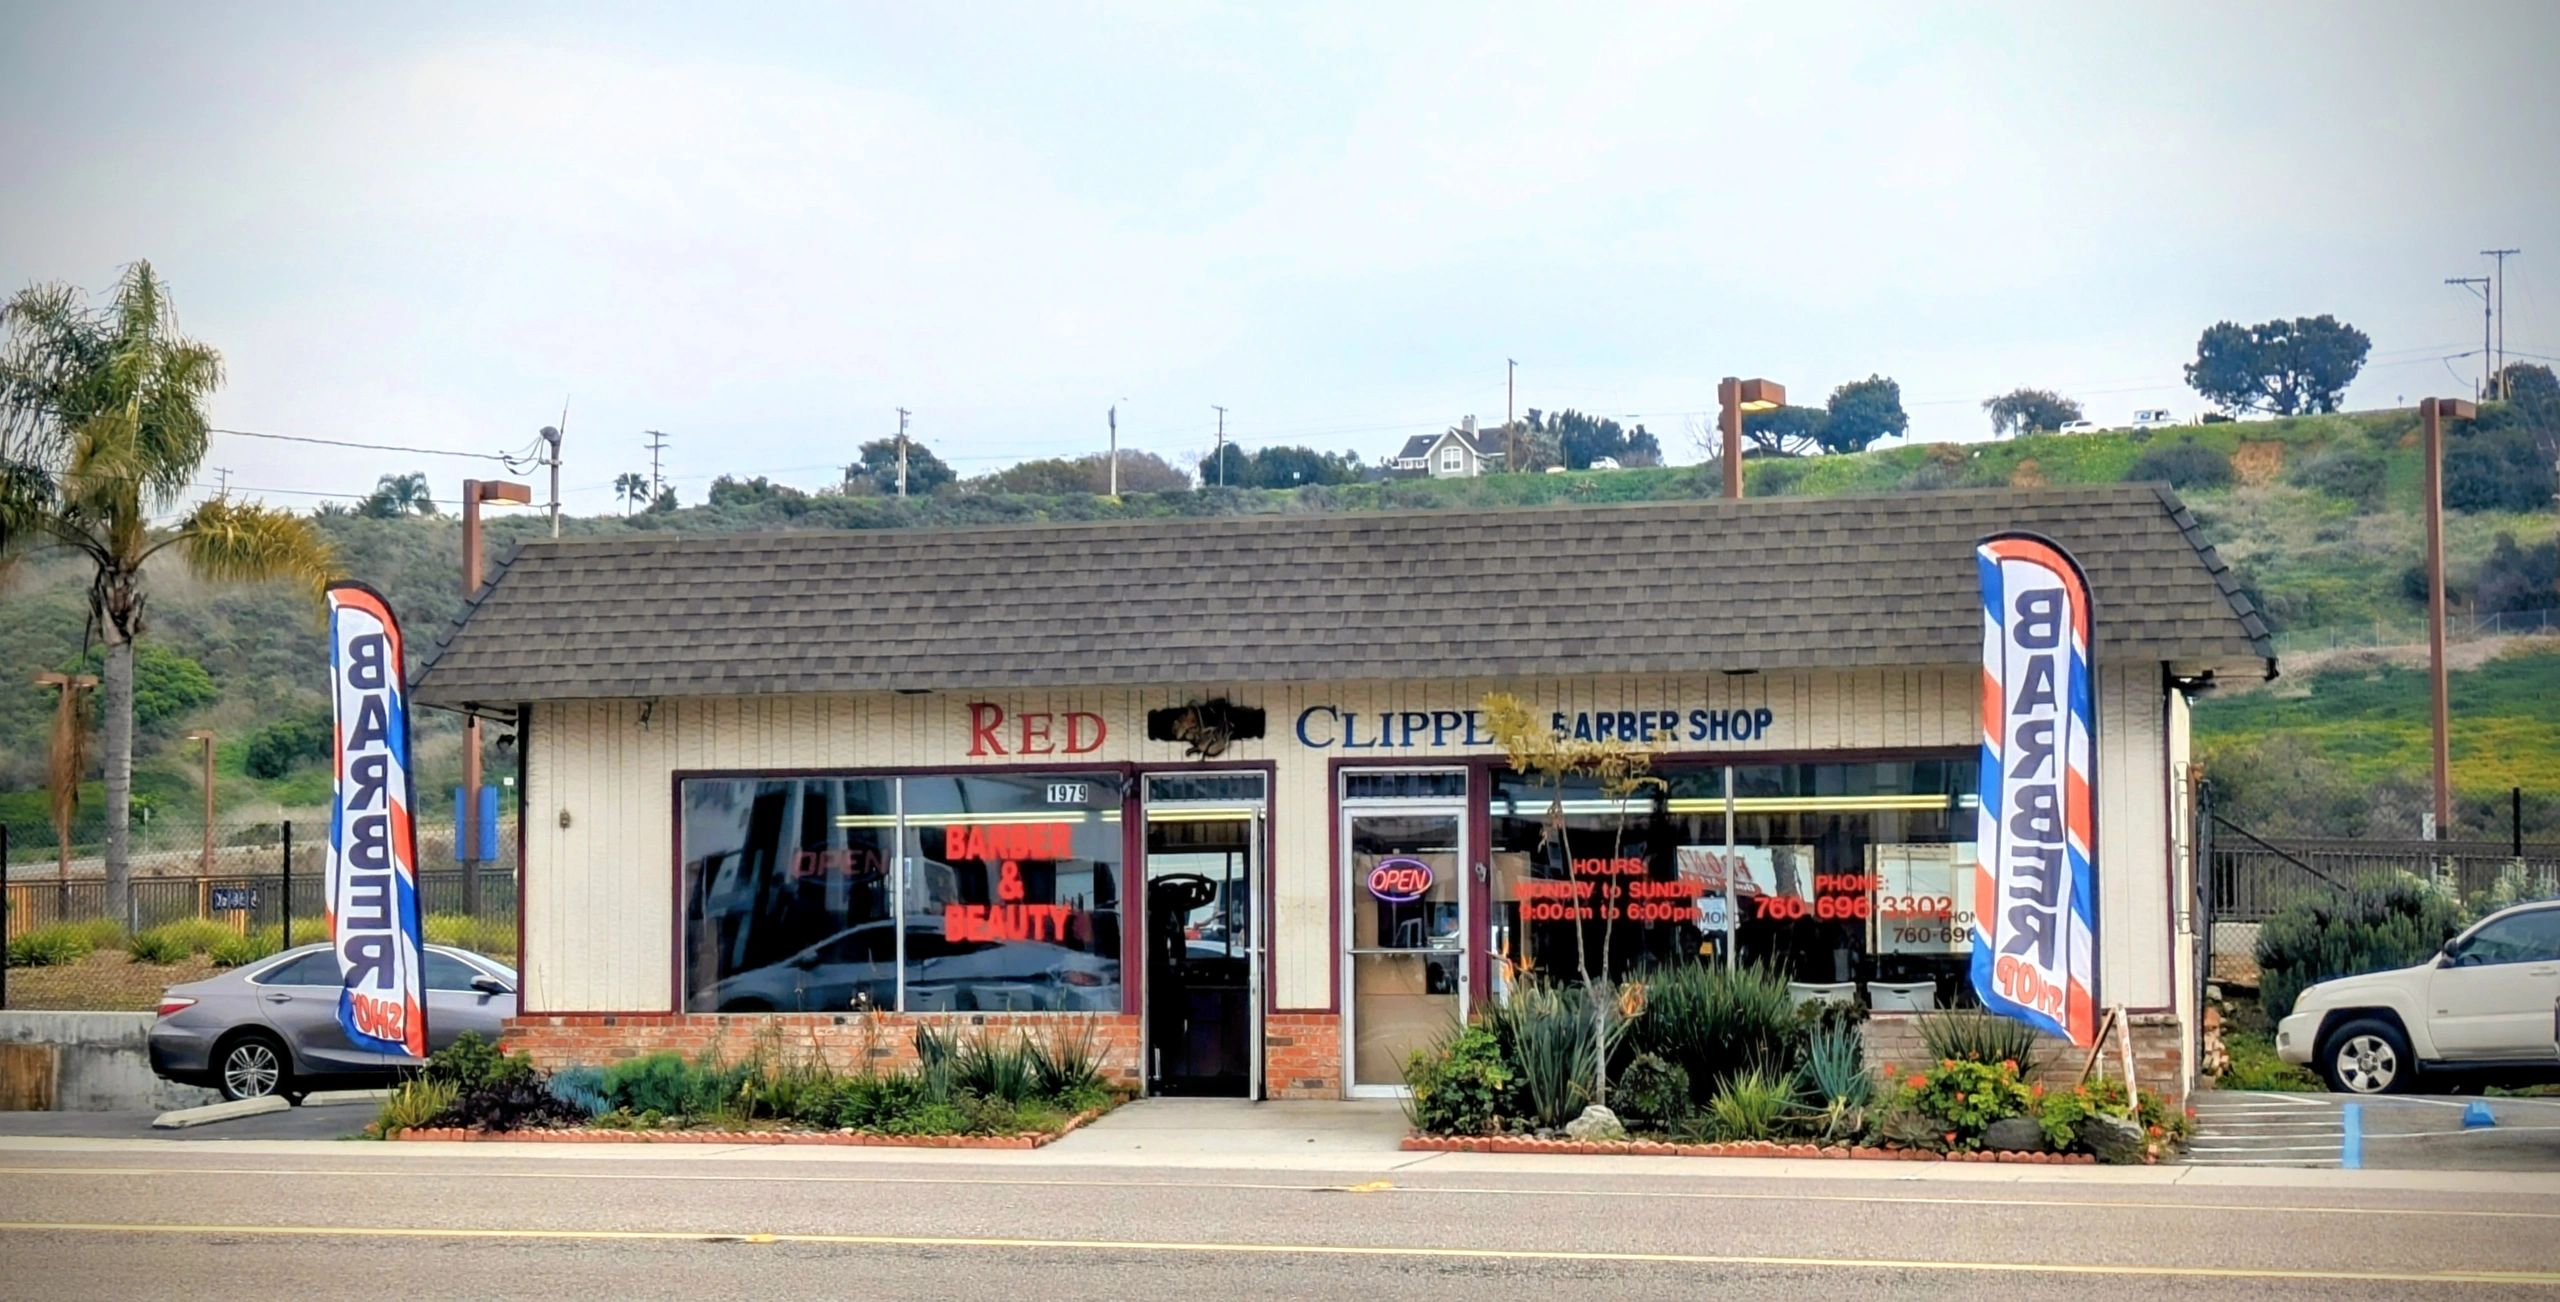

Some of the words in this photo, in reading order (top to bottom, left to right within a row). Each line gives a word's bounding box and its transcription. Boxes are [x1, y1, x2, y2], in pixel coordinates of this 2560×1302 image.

[966, 702, 1107, 756] RED
[1296, 704, 1500, 748] CLIPPE
[1552, 710, 1680, 743] BARBER
[1689, 707, 1773, 741] SHOP
[1050, 784, 1087, 802] 1979
[945, 823, 1073, 861] BARBER
[792, 847, 892, 878] OPEN
[1572, 857, 1649, 875] HOURS:
[998, 860, 1025, 900] &
[1371, 869, 1427, 892] OPEN
[1514, 881, 1596, 898] MONDAY
[1602, 881, 1621, 898] to
[1815, 873, 1890, 891] PHONE:
[944, 903, 1072, 942] BEAUTY
[1601, 903, 1620, 920] to
